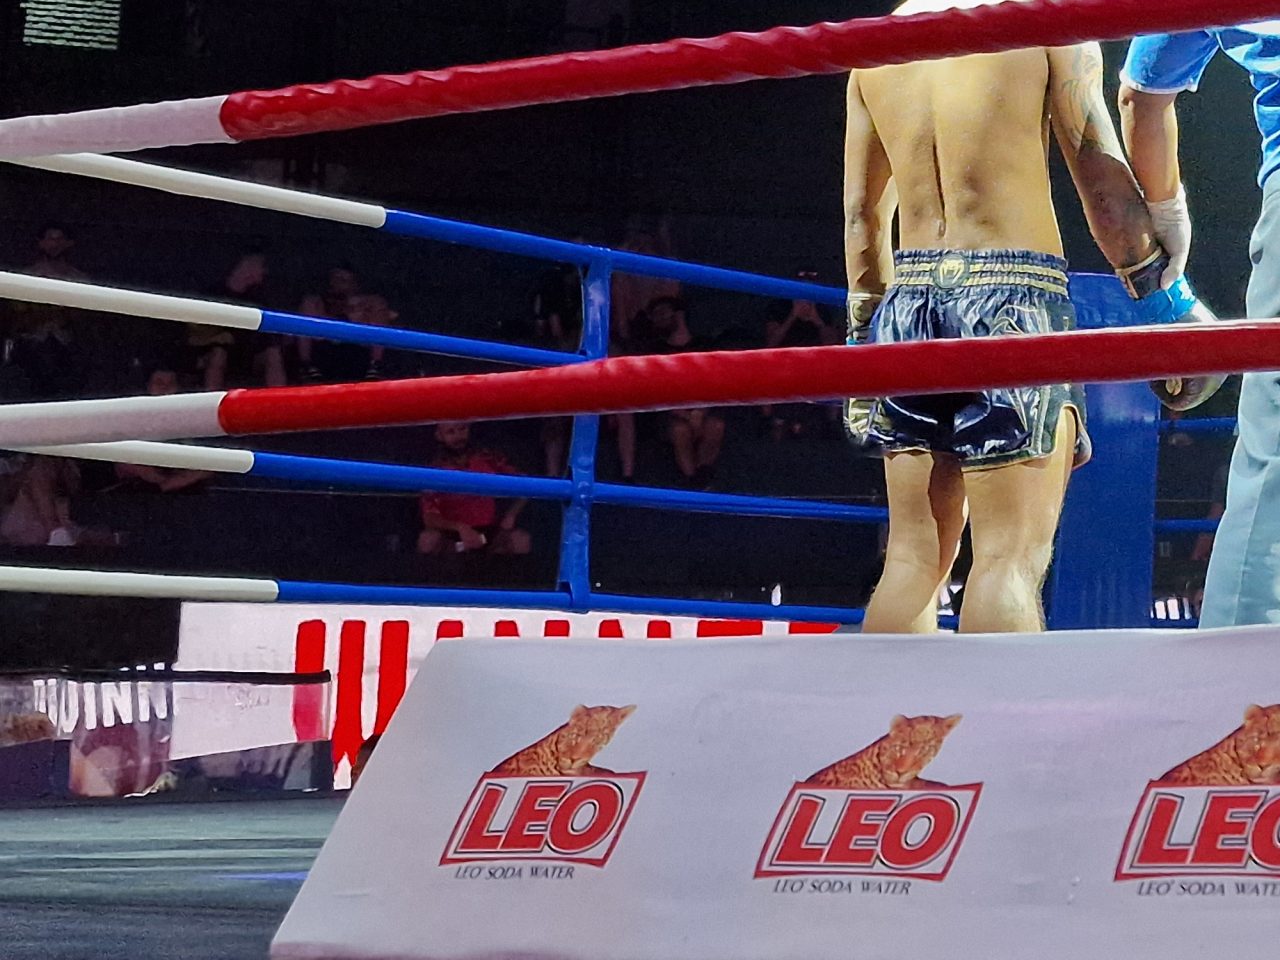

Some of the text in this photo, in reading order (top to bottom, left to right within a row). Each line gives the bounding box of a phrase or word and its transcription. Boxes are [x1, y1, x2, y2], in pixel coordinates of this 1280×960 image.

[454, 780, 623, 855] LEO
[770, 793, 960, 870] LEO
[454, 866, 576, 880] LEO SODA WATER
[807, 880, 852, 894] SODA
[861, 881, 912, 895] WATER
[1136, 879, 1173, 896] LEO
[1177, 881, 1225, 896] SODA
